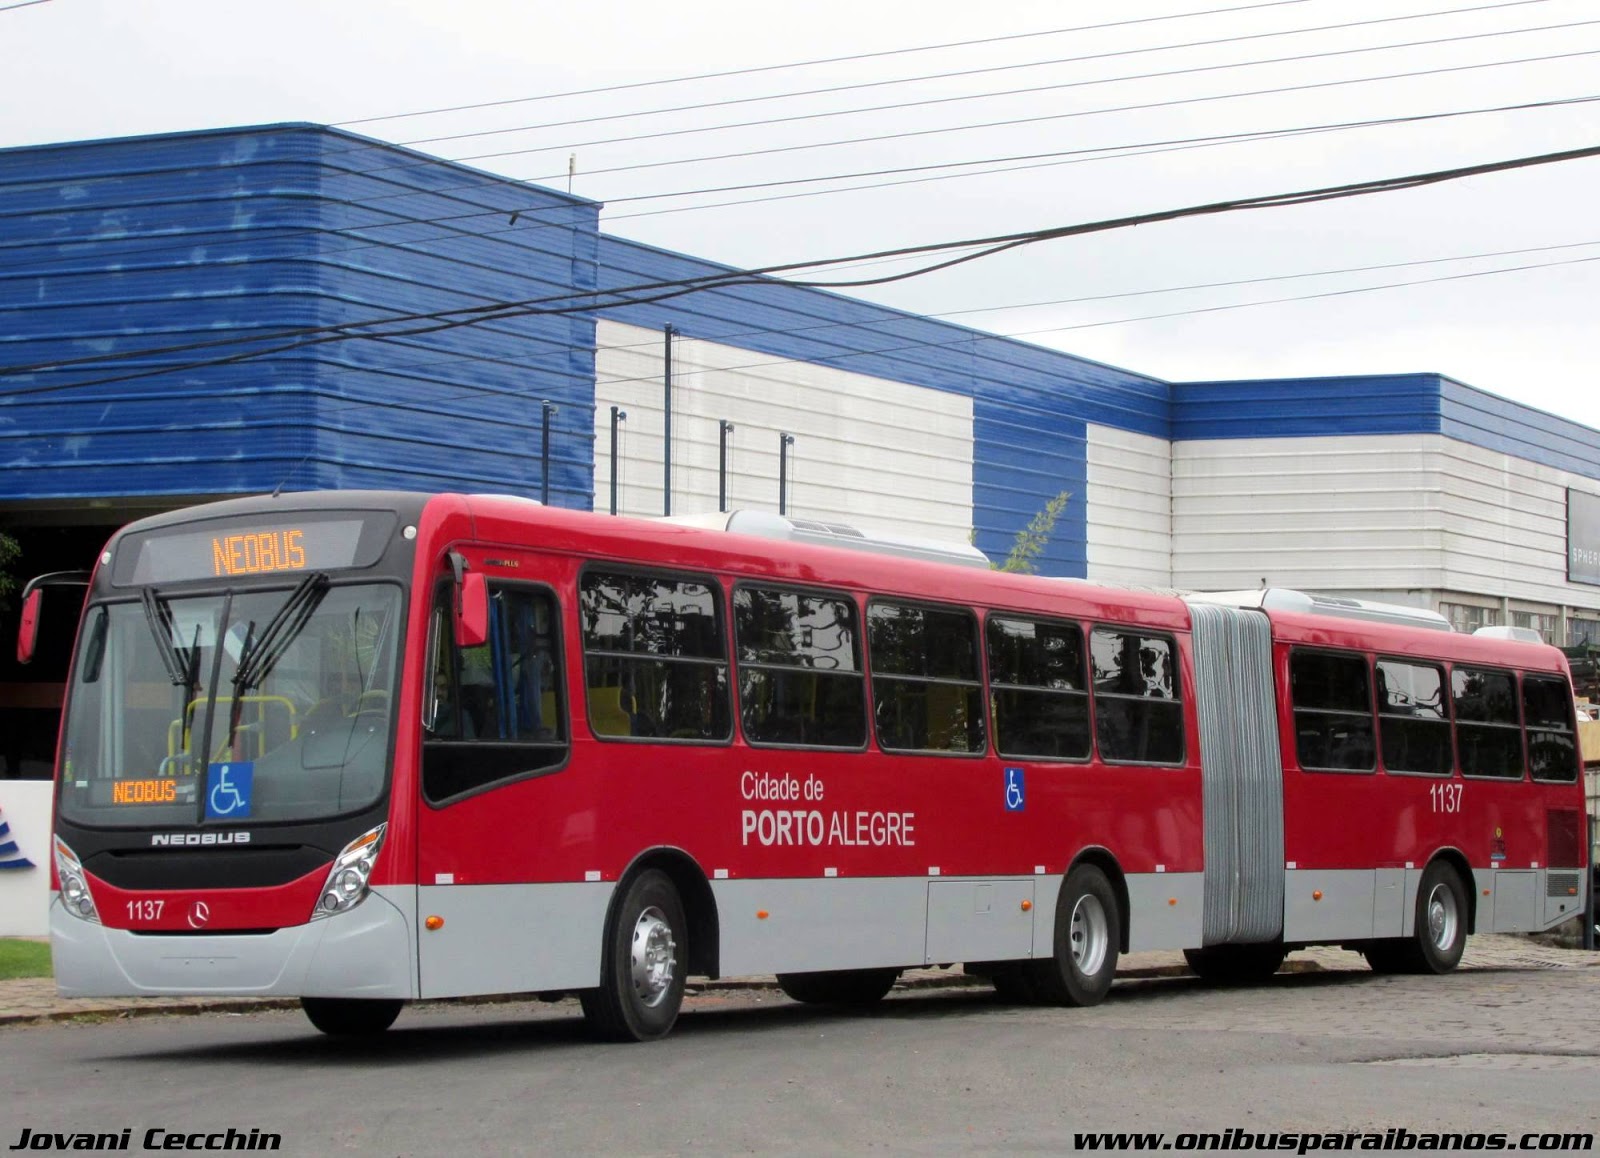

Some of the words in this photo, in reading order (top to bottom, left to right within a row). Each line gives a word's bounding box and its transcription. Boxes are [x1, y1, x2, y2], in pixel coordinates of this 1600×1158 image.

[212, 529, 305, 576] NEOBUS
[113, 780, 177, 803] NEOBUS
[741, 771, 800, 800] Cidade
[804, 773, 824, 801] de
[1430, 783, 1463, 813] 1137
[151, 832, 251, 846] NEOBUS
[742, 809, 824, 846] PORTO
[828, 811, 915, 846] ALEGRE
[126, 900, 165, 920] 1137
